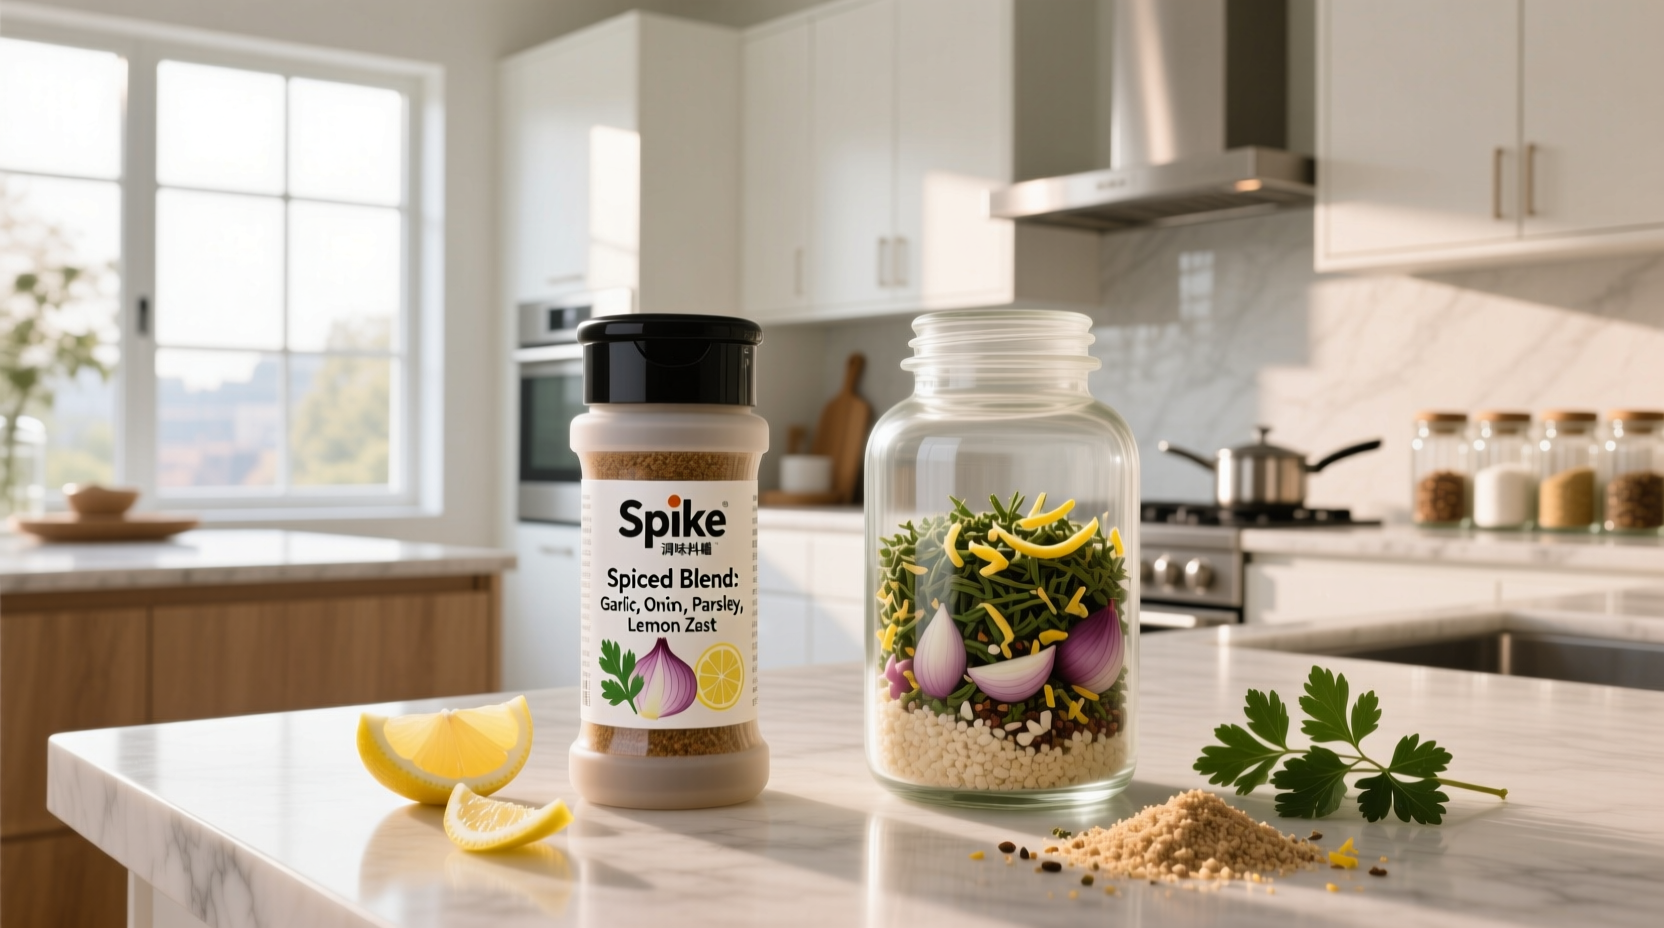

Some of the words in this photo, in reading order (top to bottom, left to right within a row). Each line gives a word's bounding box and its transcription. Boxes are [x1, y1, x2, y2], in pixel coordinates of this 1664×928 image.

[618, 494, 727, 549] Spike
[607, 567, 673, 594] Spiced
[680, 567, 739, 589] Blend:
[600, 595, 641, 615] Garlic,
[692, 594, 744, 616] Parsley,
[628, 617, 681, 633] Lemon
